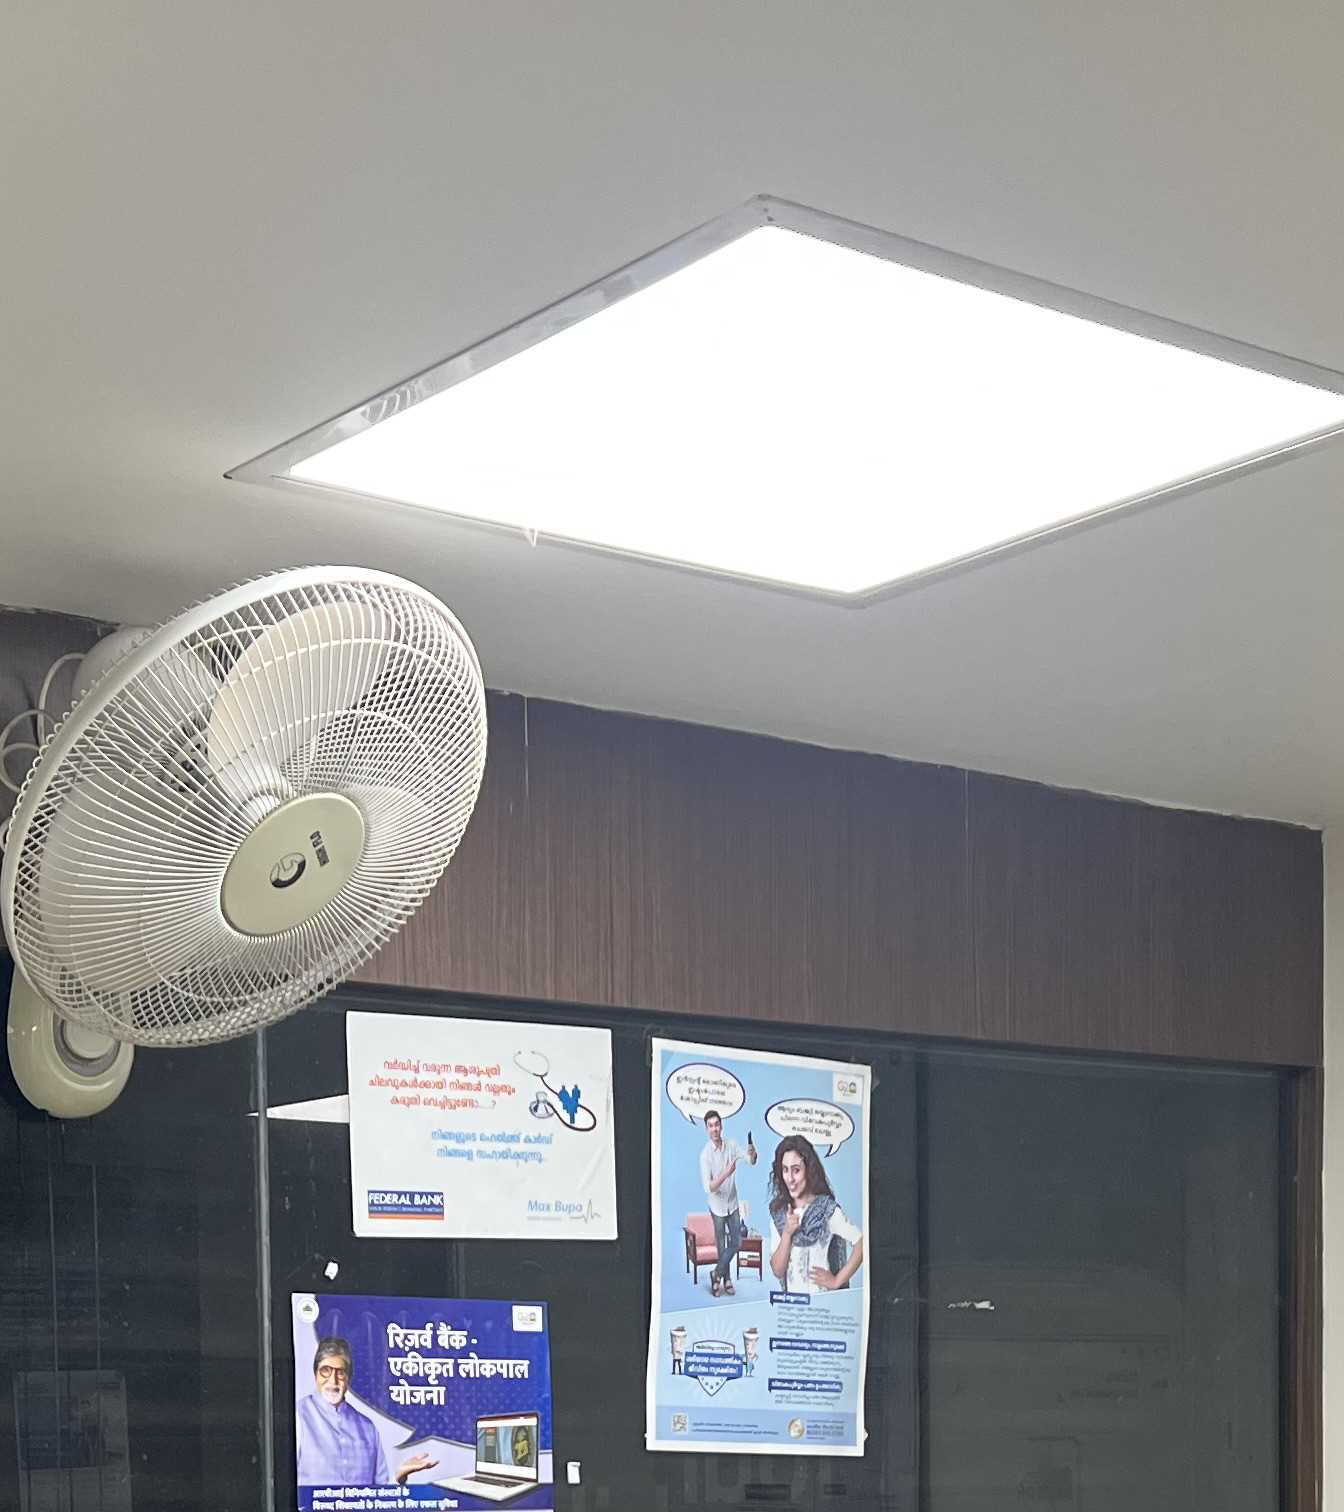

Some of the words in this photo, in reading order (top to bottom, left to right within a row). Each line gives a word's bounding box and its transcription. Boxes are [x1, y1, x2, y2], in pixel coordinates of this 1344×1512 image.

[369, 1193, 413, 1205] FEDERAL
[414, 1194, 444, 1206] BANK
[386, 1323, 434, 1350] रिज़र्व
[436, 1323, 469, 1350] बैंक
[388, 1354, 454, 1384] एकीकृत
[457, 1352, 530, 1379] लोकपाल
[389, 1379, 446, 1406] योजना
